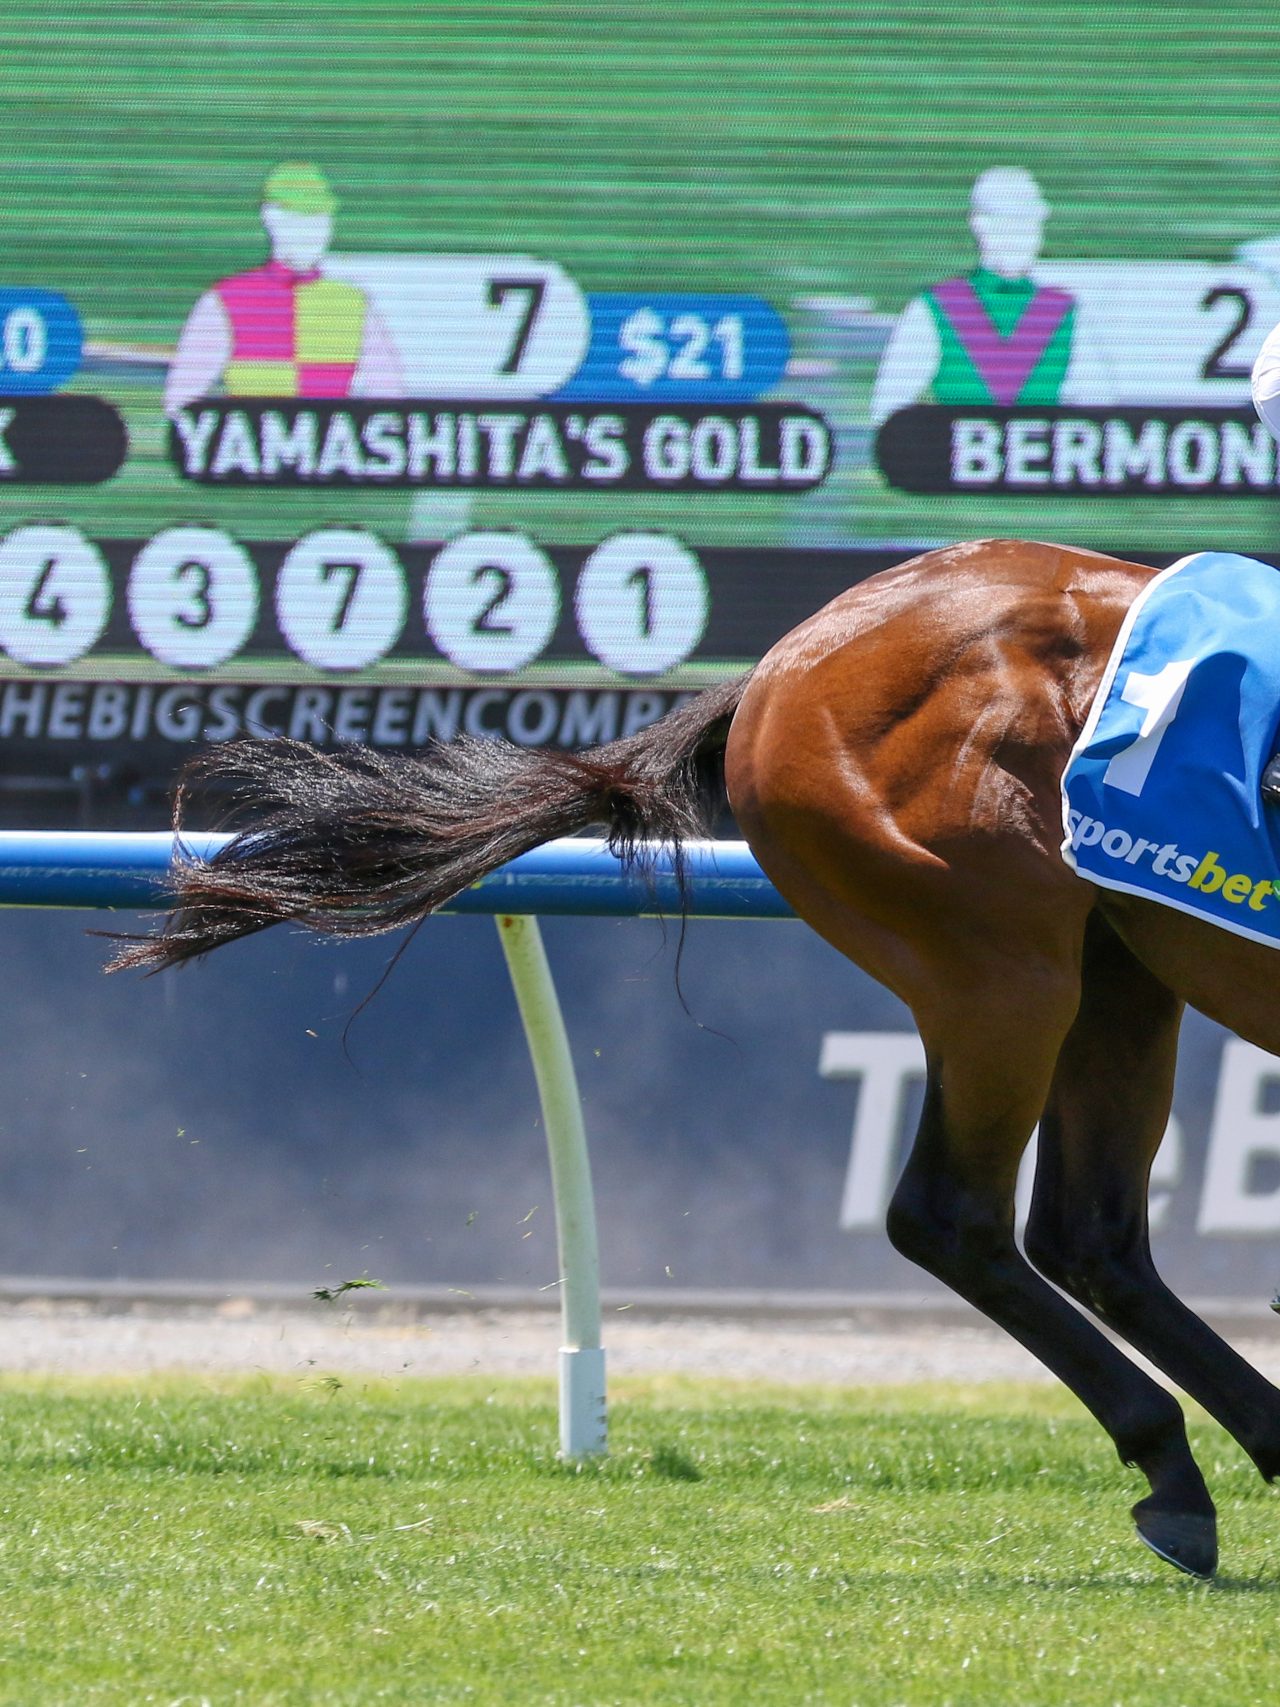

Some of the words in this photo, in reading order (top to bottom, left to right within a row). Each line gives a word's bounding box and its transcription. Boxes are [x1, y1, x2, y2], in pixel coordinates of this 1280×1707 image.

[0, 305, 47, 374] 0
[488, 277, 549, 376] 7
[617, 306, 745, 389] $21
[1199, 284, 1254, 381] 2
[171, 409, 631, 480] YAMASHITA'S
[642, 413, 829, 481] GOLD
[24, 557, 68, 628] 4
[174, 559, 214, 629] 3
[322, 561, 365, 634] 7
[471, 563, 515, 633] 2
[625, 563, 654, 637] 1
[1102, 656, 1199, 798] 1
[1067, 807, 1274, 912] sportsbet
